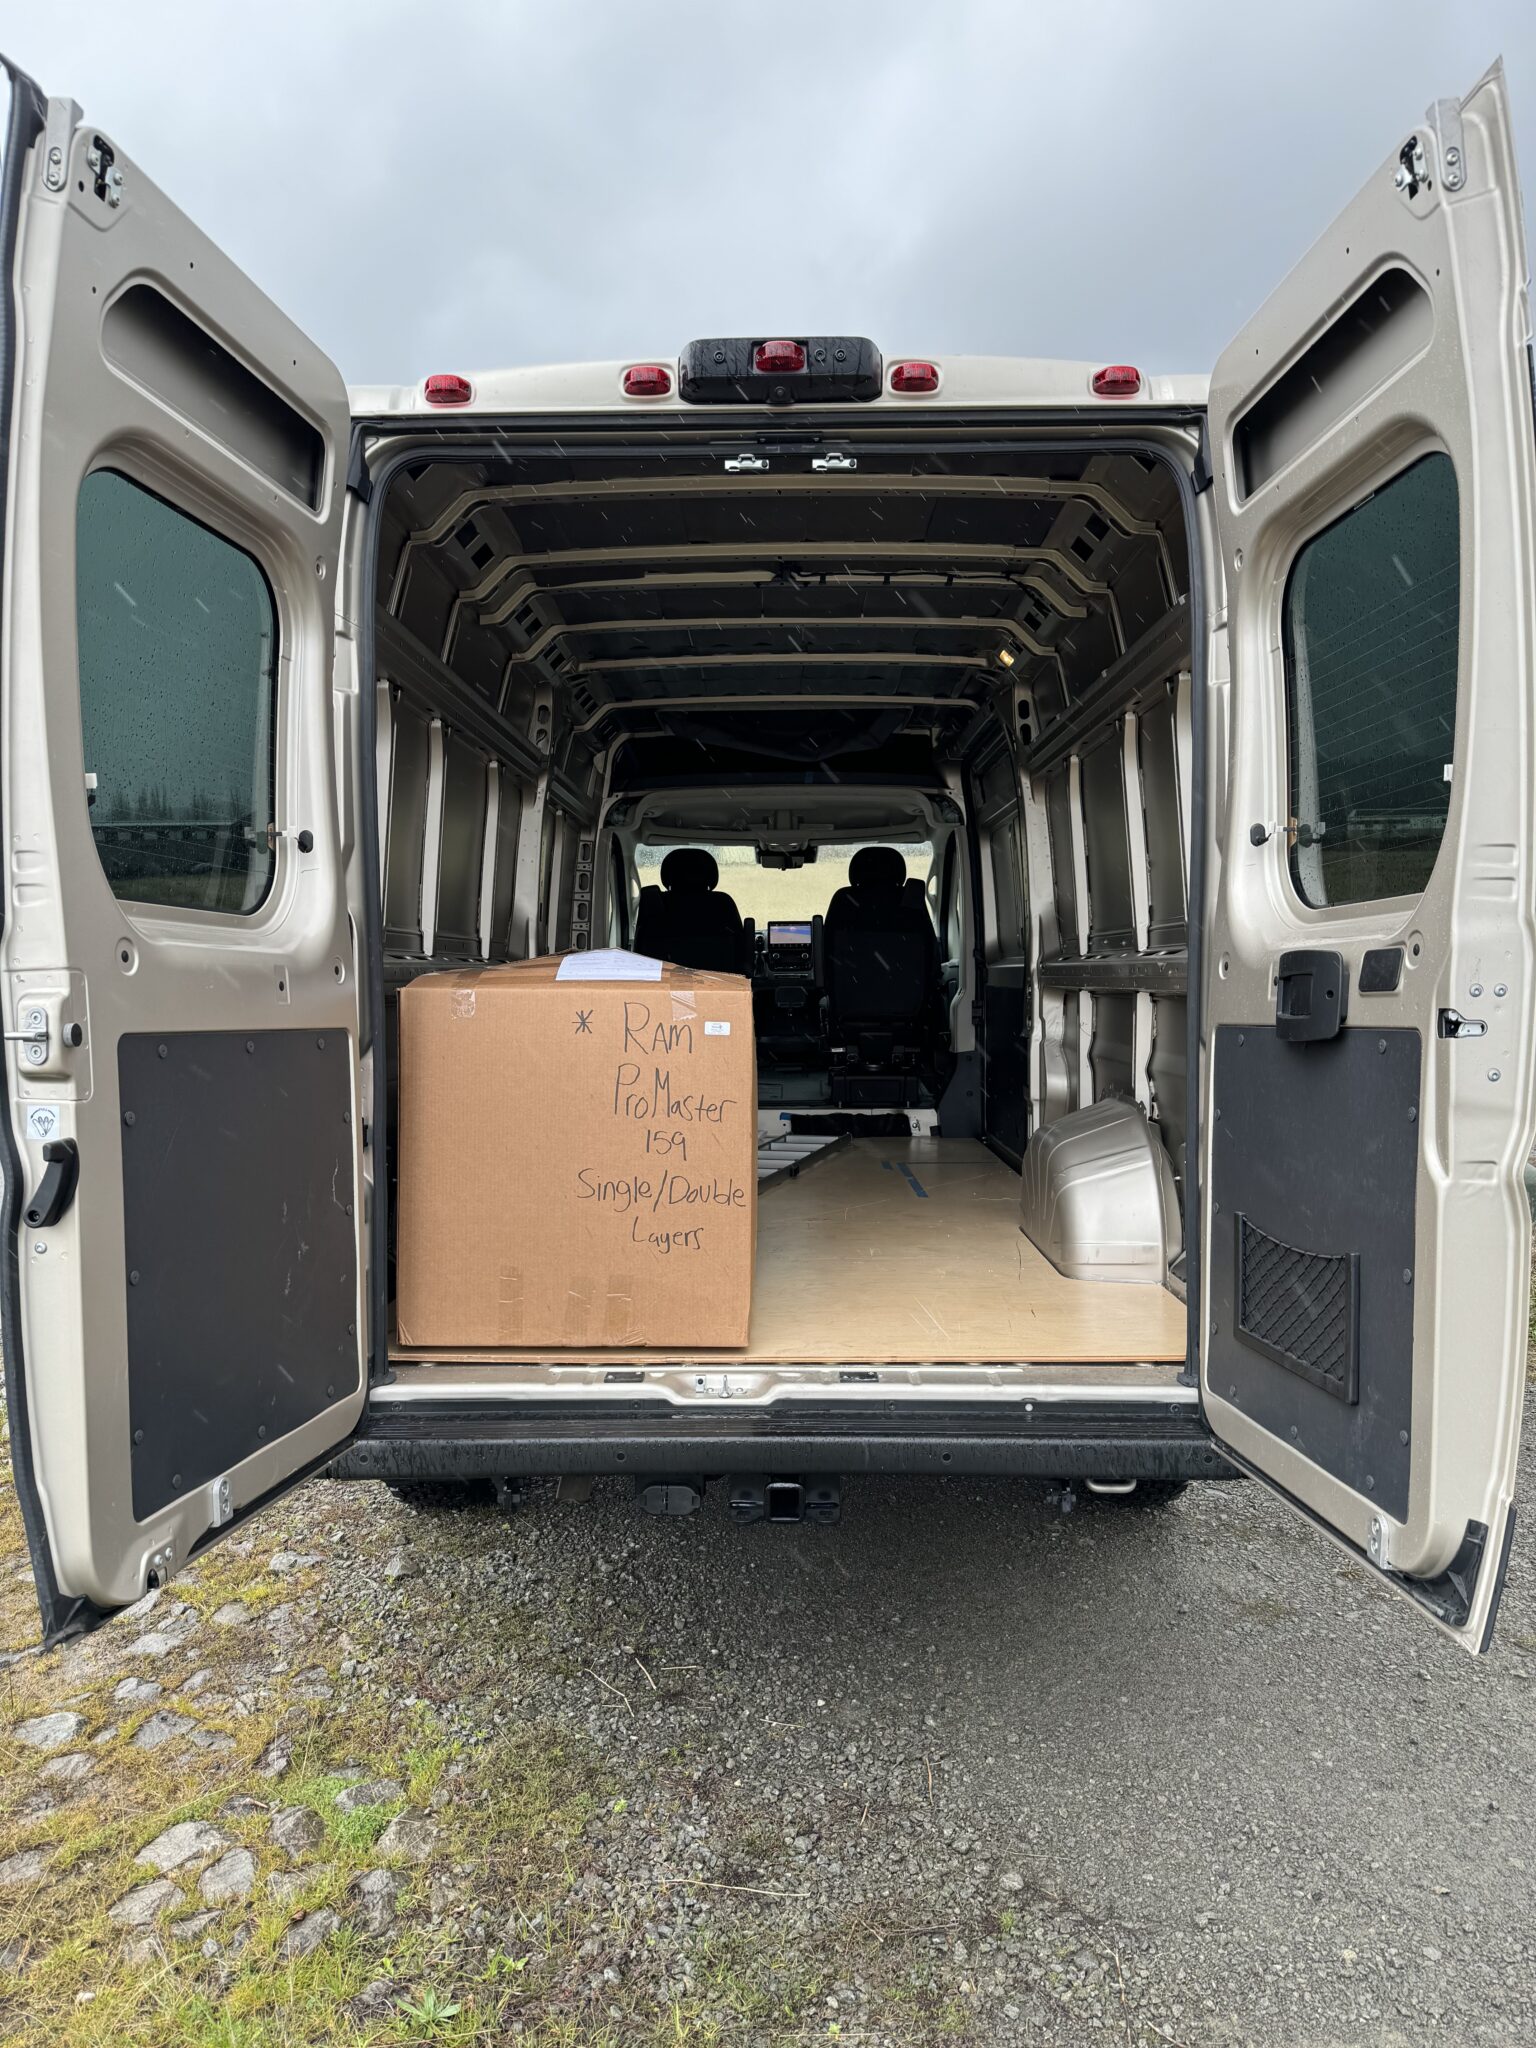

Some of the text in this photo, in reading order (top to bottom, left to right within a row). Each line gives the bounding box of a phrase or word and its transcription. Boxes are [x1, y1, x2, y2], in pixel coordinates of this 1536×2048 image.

[614, 1063, 737, 1122] ProMaster
[646, 1129, 687, 1161] 159
[577, 1168, 746, 1212] Single/Double
[632, 1216, 704, 1254] Layers
